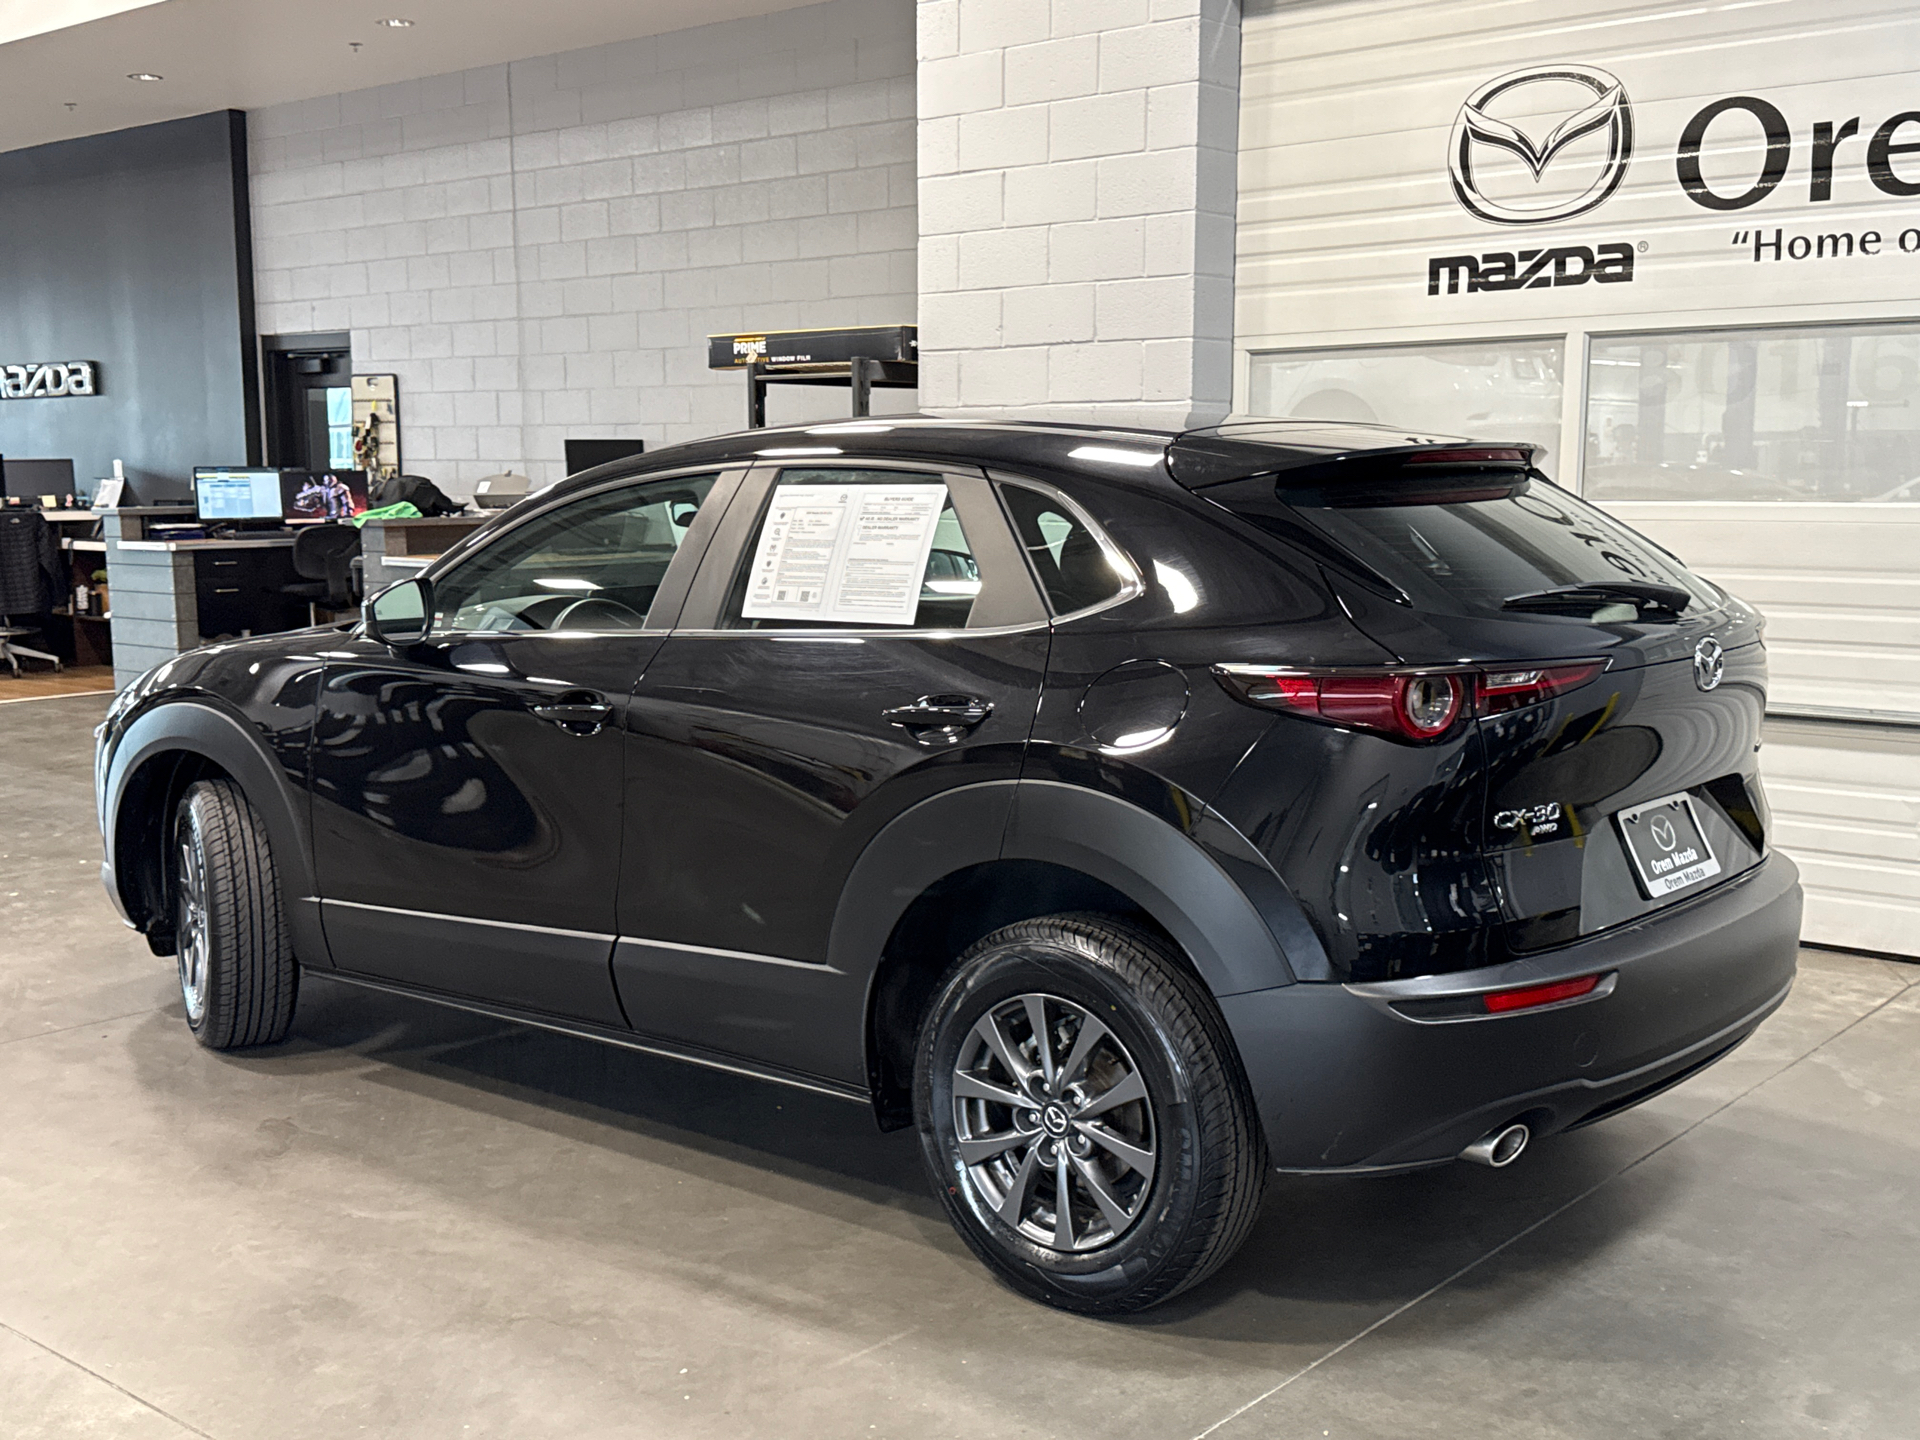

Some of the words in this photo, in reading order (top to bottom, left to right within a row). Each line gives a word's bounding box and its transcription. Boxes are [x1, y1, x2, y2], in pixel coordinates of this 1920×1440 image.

[1676, 96, 1920, 211] Ore
[733, 341, 767, 354] PRIME
[734, 356, 769, 364] AUTTIVE
[0, 362, 92, 398] azda
[1494, 802, 1561, 829] CX-30
[1531, 822, 1558, 836] AWD
[1650, 857, 1674, 875] Orem
[1671, 846, 1699, 867] Mazda
[1664, 875, 1684, 890] Orem
[1682, 867, 1706, 882] Mazda
